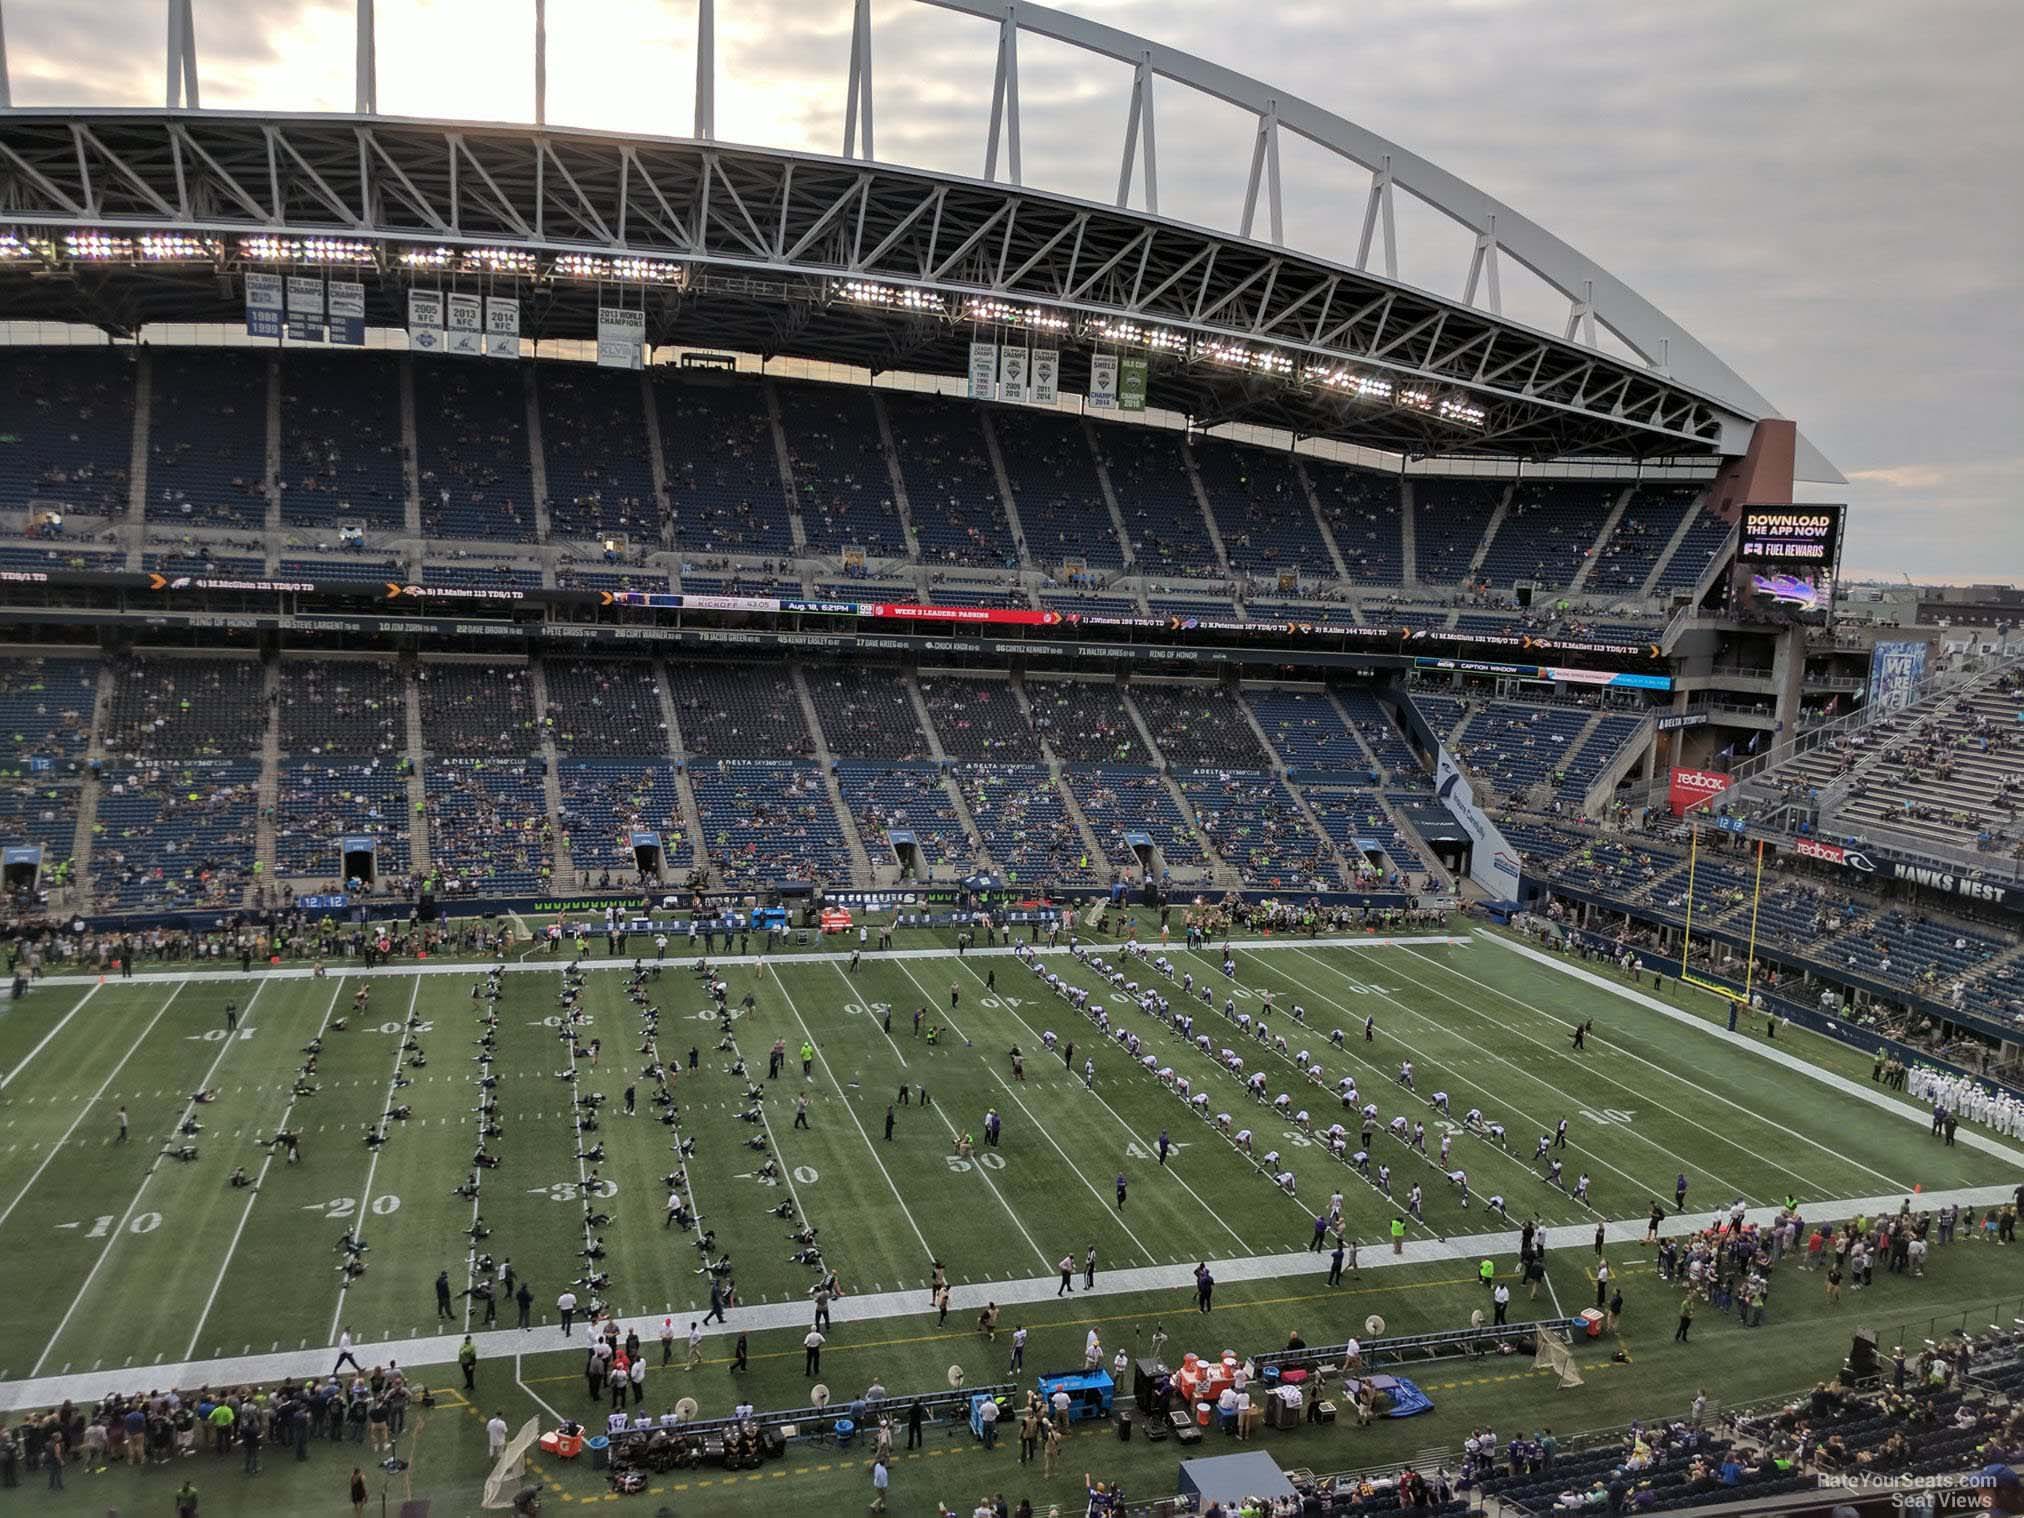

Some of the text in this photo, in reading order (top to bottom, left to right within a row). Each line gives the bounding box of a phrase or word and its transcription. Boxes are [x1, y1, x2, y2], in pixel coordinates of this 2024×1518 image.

[248, 282, 281, 290] CHAMPS
[288, 287, 322, 296] CHAMPS
[330, 291, 363, 299] CHAMPS
[415, 304, 438, 314] 2005
[453, 308, 477, 318] 2013
[417, 314, 434, 322] NFC
[491, 312, 514, 322] 2014
[600, 310, 643, 320] 2013 WORLD
[494, 322, 511, 330] NFC
[600, 318, 643, 327] CHAMPIONS
[1003, 351, 1026, 360] CHAMPS
[1034, 354, 1057, 362] CHAMPS
[1093, 362, 1116, 370] SHIELD
[1747, 515, 1830, 527] DOWNLOAD
[1746, 526, 1828, 537] THE APP NOW
[1765, 543, 1824, 558] FUEL REWARDS
[32, 573, 47, 581] TD
[301, 583, 314, 591] TD
[512, 591, 523, 599] TD
[698, 601, 737, 609] KICKOFF
[821, 604, 849, 612] 6:21PM
[292, 621, 312, 629] STEVE
[314, 621, 344, 630] LARGENT
[379, 622, 390, 631] 10
[456, 625, 467, 633] 22
[468, 625, 484, 633] DAVE
[547, 627, 561, 636] PETE
[808, 637, 827, 645] EASLEY
[880, 640, 896, 648] KRIEG
[1606, 646, 1627, 654] YDS/1
[1176, 651, 1198, 659] HONOR
[1490, 665, 1517, 673] WINDOW
[1886, 658, 1911, 675] WE
[1665, 717, 1681, 728] DELTA
[1720, 818, 1729, 829] 12
[1733, 822, 1743, 831] 12
[1895, 864, 2006, 903] HAWKS NEST
[305, 897, 318, 907] 12
[330, 896, 342, 907] 12
[945, 1152, 1006, 1173] 50
[551, 1180, 618, 1201] 30
[326, 1195, 401, 1218] 20
[86, 1212, 163, 1238] 10
